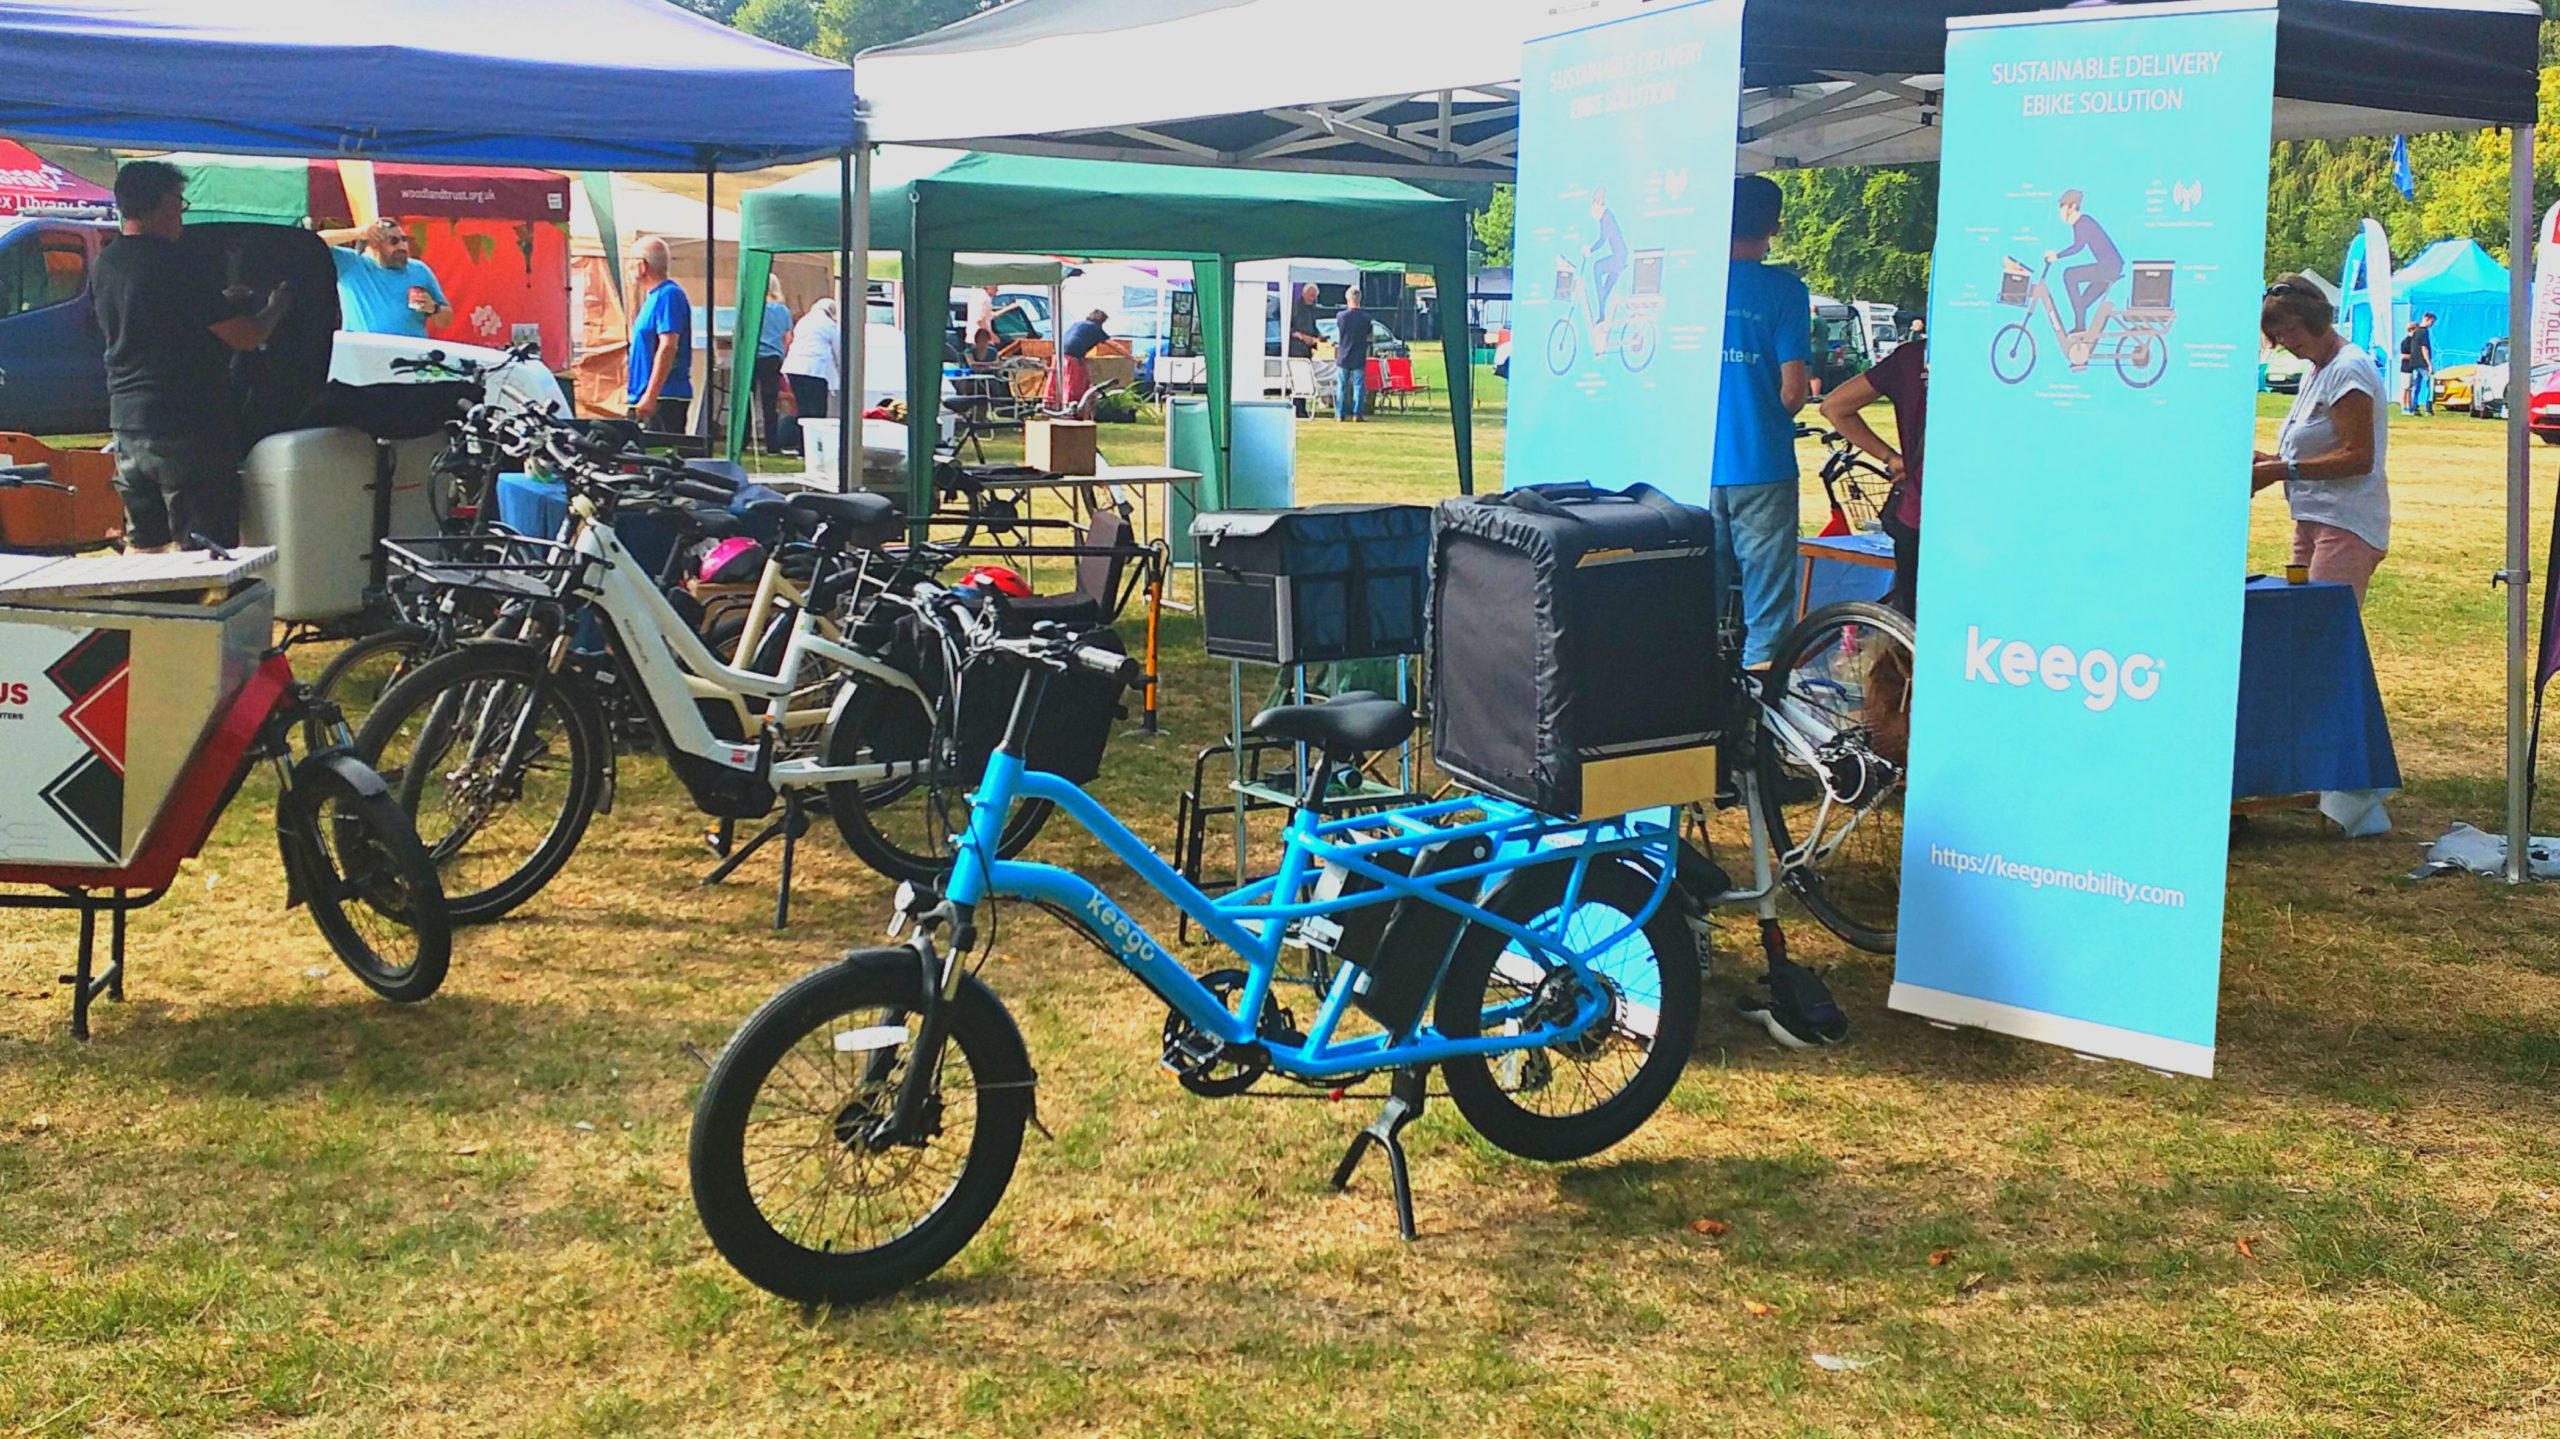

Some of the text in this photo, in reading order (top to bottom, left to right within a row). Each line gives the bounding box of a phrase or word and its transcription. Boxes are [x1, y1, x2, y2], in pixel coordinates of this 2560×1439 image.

[1991, 51, 2223, 85] SUSTAINABLE DELIVERY
[2022, 88, 2184, 117] EBIKE SOLUTION
[1965, 625, 2160, 712] keego
[1930, 843, 2185, 908] https://keegomobility.com
[1086, 889, 1155, 961] keego
